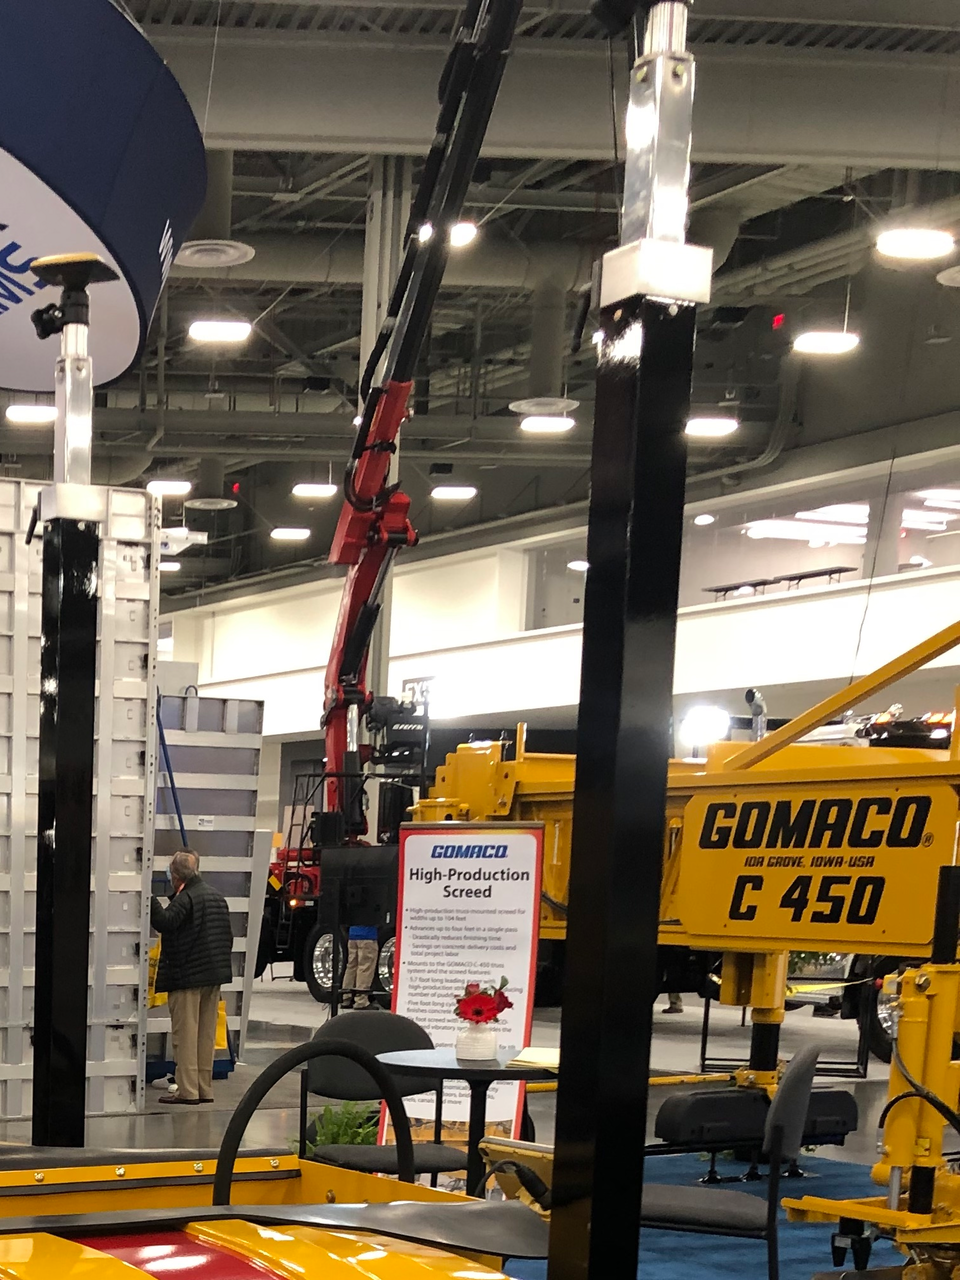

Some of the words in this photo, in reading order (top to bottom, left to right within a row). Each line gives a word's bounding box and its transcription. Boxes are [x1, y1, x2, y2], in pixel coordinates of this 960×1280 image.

[431, 844, 508, 859] GOMACO
[744, 856, 764, 867] IDA
[409, 867, 530, 883] High-Production
[442, 885, 492, 899] Screed
[729, 876, 764, 920] C
[780, 876, 885, 925] 450
